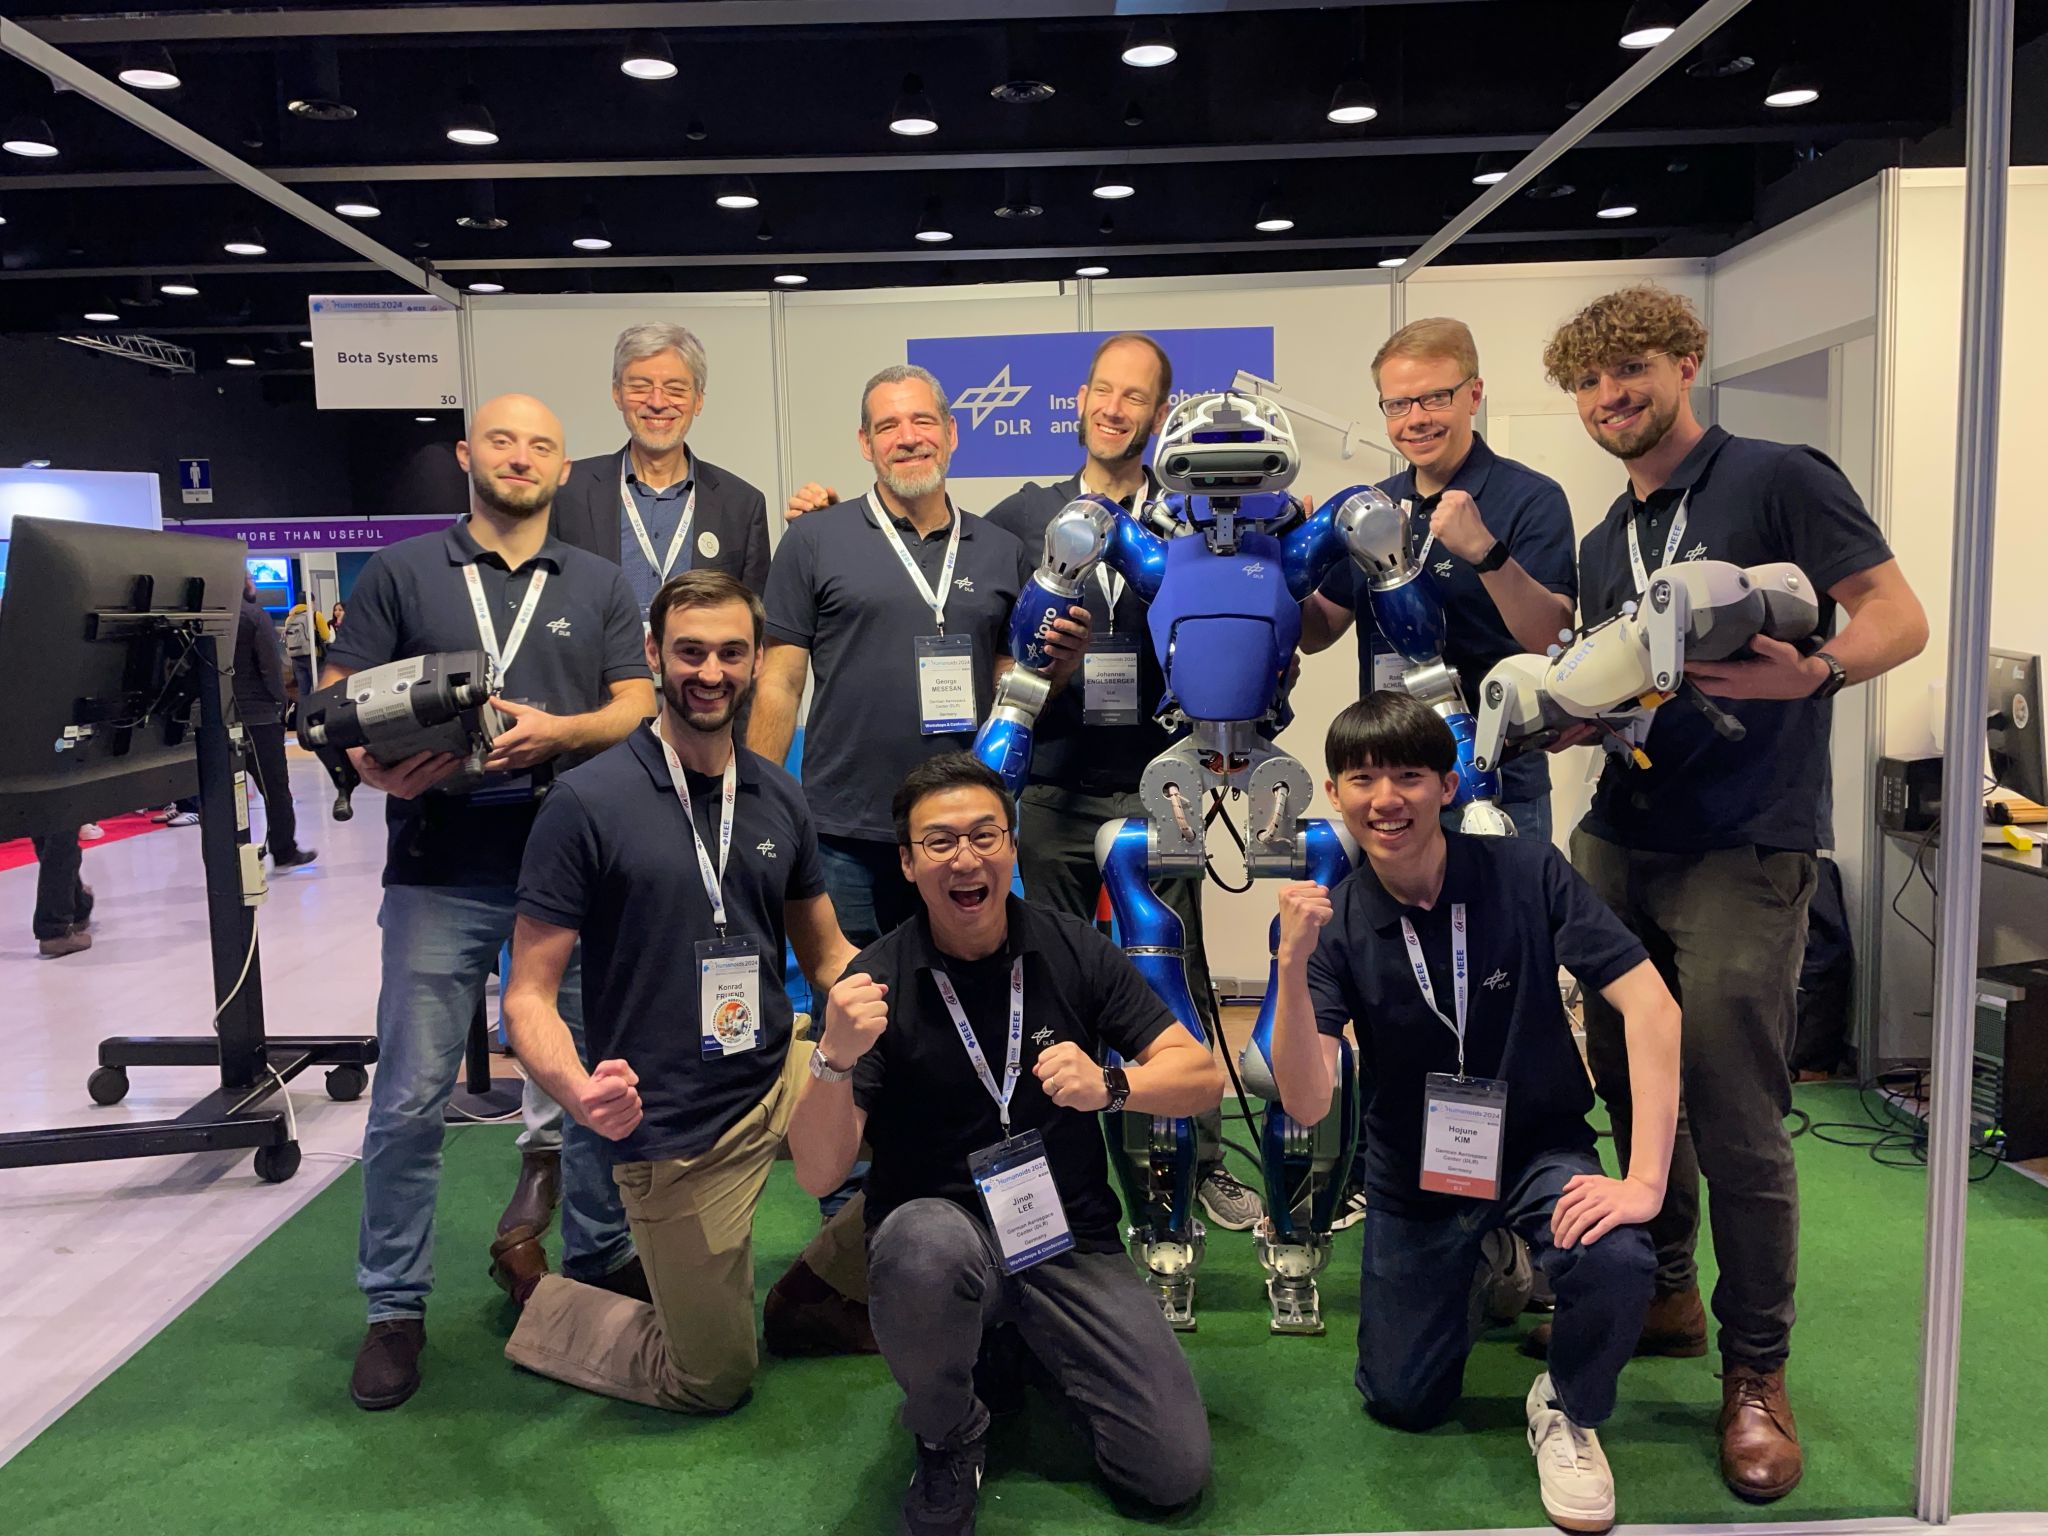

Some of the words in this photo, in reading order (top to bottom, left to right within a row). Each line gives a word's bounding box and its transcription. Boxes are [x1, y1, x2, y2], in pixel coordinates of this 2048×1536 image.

[338, 352, 372, 363] Bota
[377, 352, 438, 365] Systems
[441, 395, 456, 404] 30
[1050, 394, 1078, 410] Ins
[995, 419, 1032, 436] DLR
[236, 531, 276, 541] MORE
[284, 530, 321, 540] THAN
[329, 529, 384, 540] USEFUL
[1669, 524, 1682, 545] IEEE
[1034, 607, 1057, 640] toro
[1563, 640, 1595, 671] bert
[723, 819, 731, 838] IEEE
[1456, 949, 1465, 970] IEEE
[1415, 962, 1427, 983] IEEE
[718, 983, 743, 991] Konrad
[1497, 981, 1511, 989] DLR
[1012, 1010, 1021, 1031] IEEE
[958, 1019, 973, 1041] IEEE
[1483, 1111, 1500, 1119] 2024
[1448, 1125, 1478, 1136] Hojune
[1454, 1136, 1471, 1144] KIM
[998, 1168, 1031, 1184] Humanoids
[1031, 1161, 1047, 1172] 2024
[1012, 1192, 1034, 1206] Jinoh
[1017, 1202, 1034, 1214] LEE
